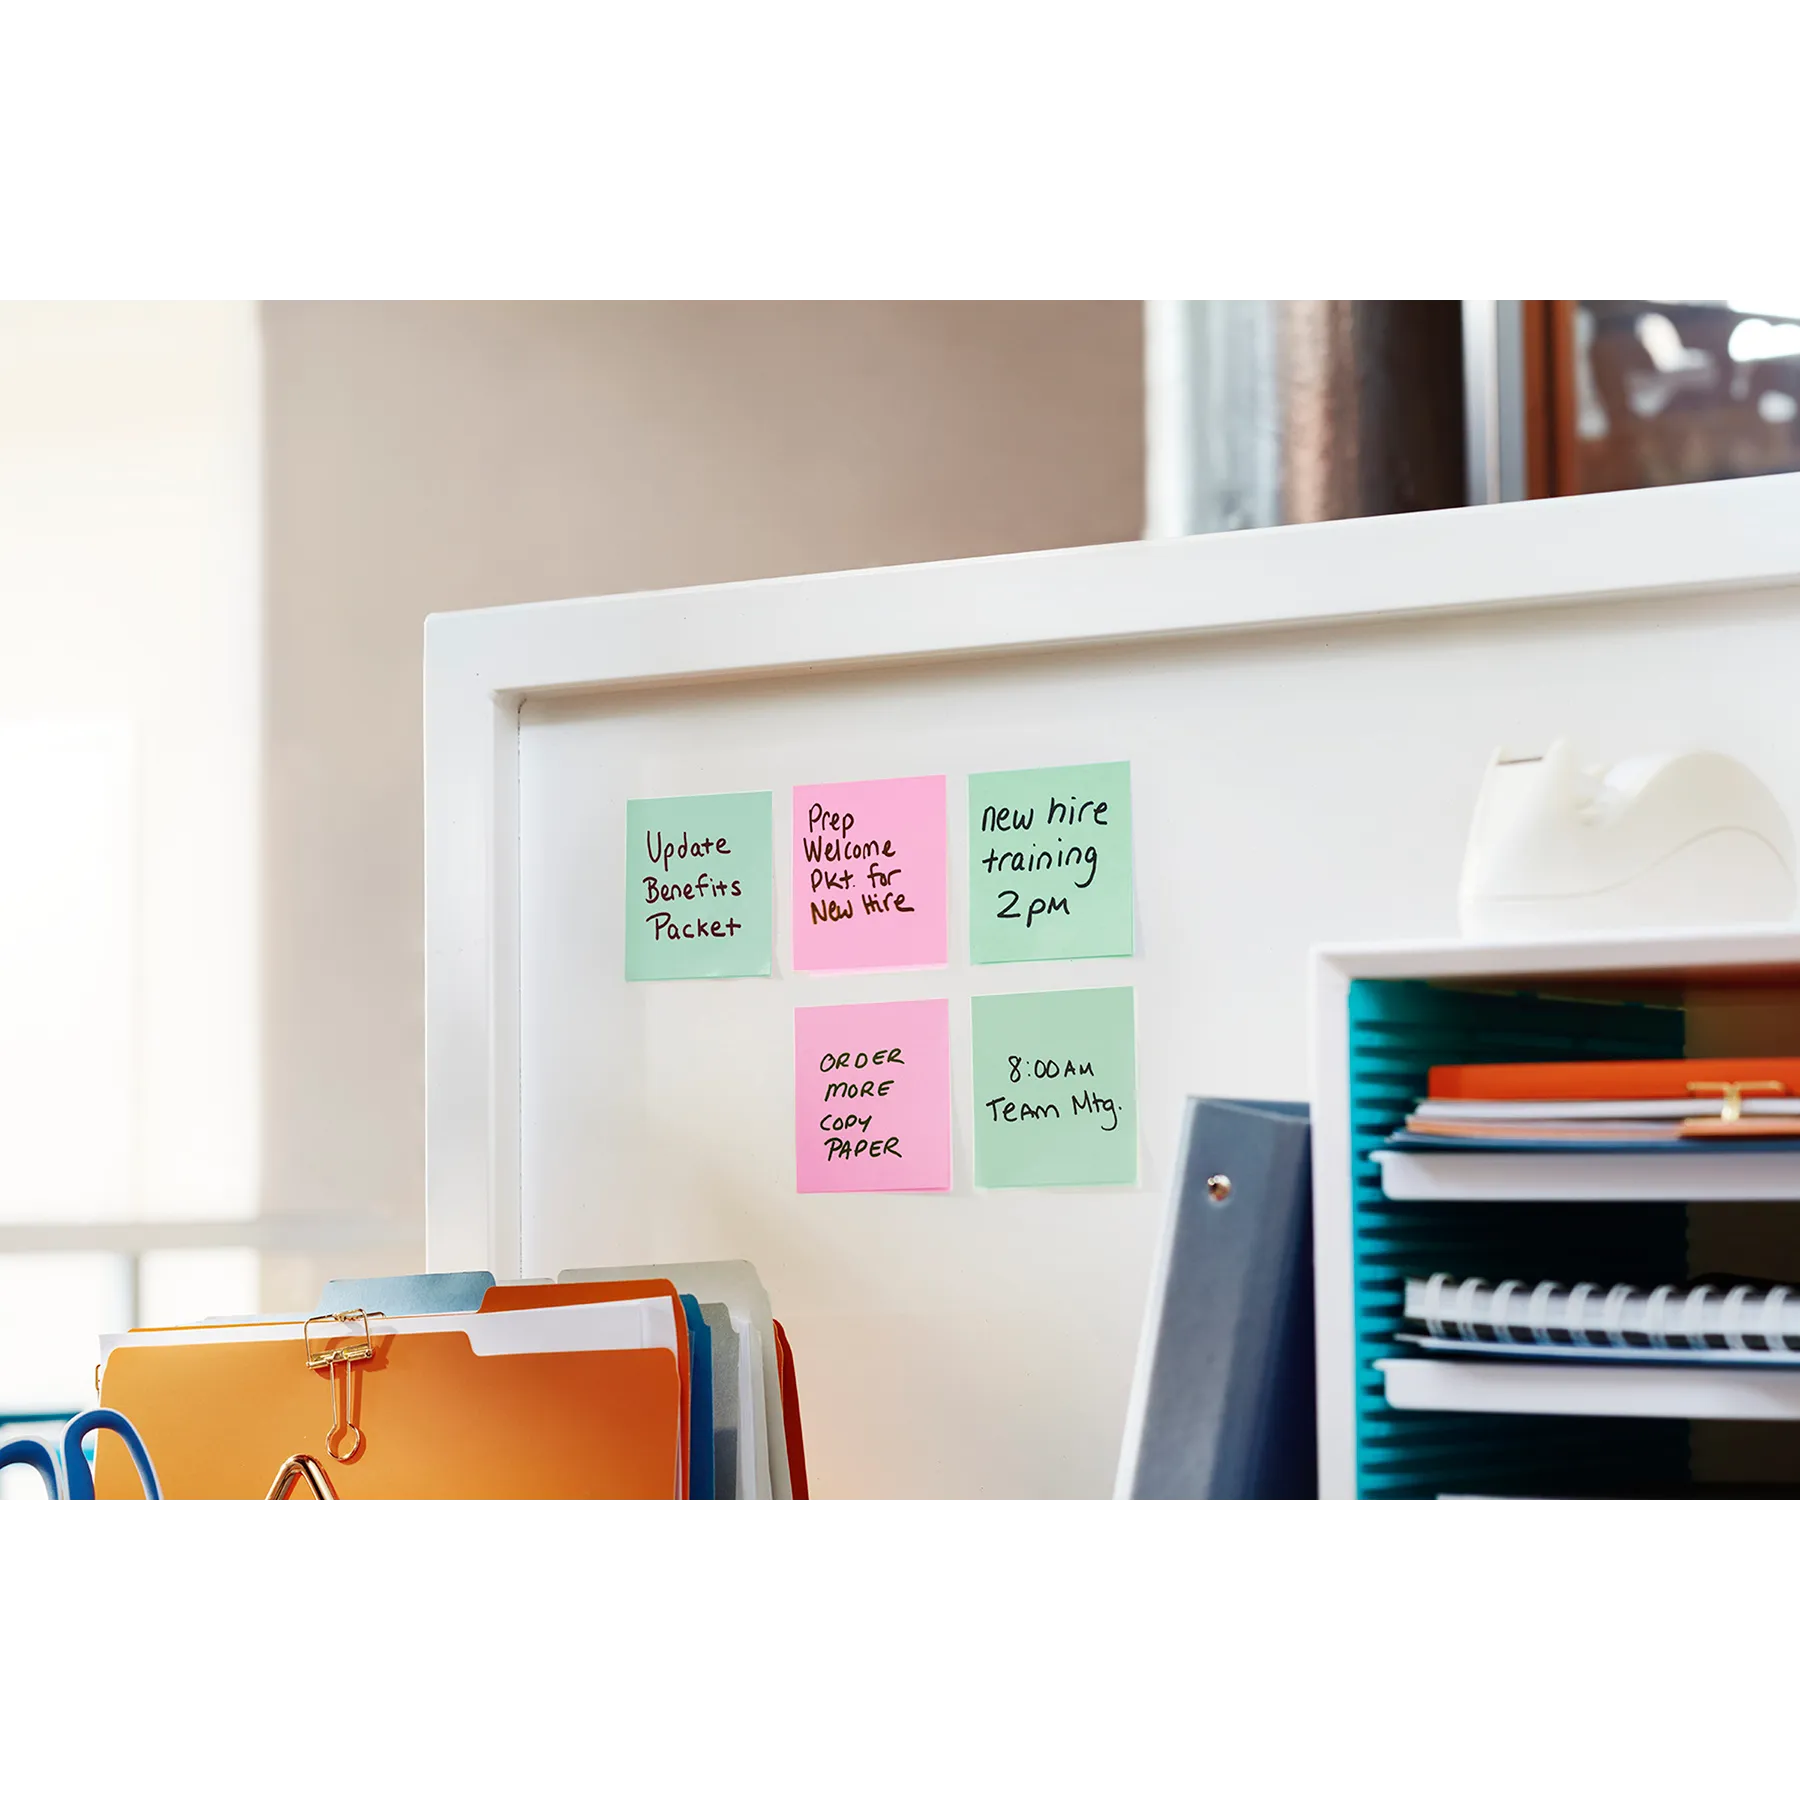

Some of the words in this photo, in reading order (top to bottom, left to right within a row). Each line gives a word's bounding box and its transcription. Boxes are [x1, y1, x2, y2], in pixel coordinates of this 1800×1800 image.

[808, 802, 855, 839] Prep
[981, 805, 1034, 832] new
[1047, 796, 1108, 826] hire
[646, 830, 732, 872] Update
[802, 834, 896, 863] Welcome
[981, 837, 1098, 889] training
[642, 872, 742, 904] Benefits
[866, 861, 902, 889] for
[810, 899, 854, 925] New
[861, 891, 915, 916] Hire
[645, 911, 742, 941] Packet
[819, 1048, 905, 1073] ORDER
[824, 1080, 895, 1102] MORE
[819, 1114, 873, 1133] COPY
[1071, 1089, 1123, 1132] Mtg.
[823, 1136, 903, 1162] PAPER
